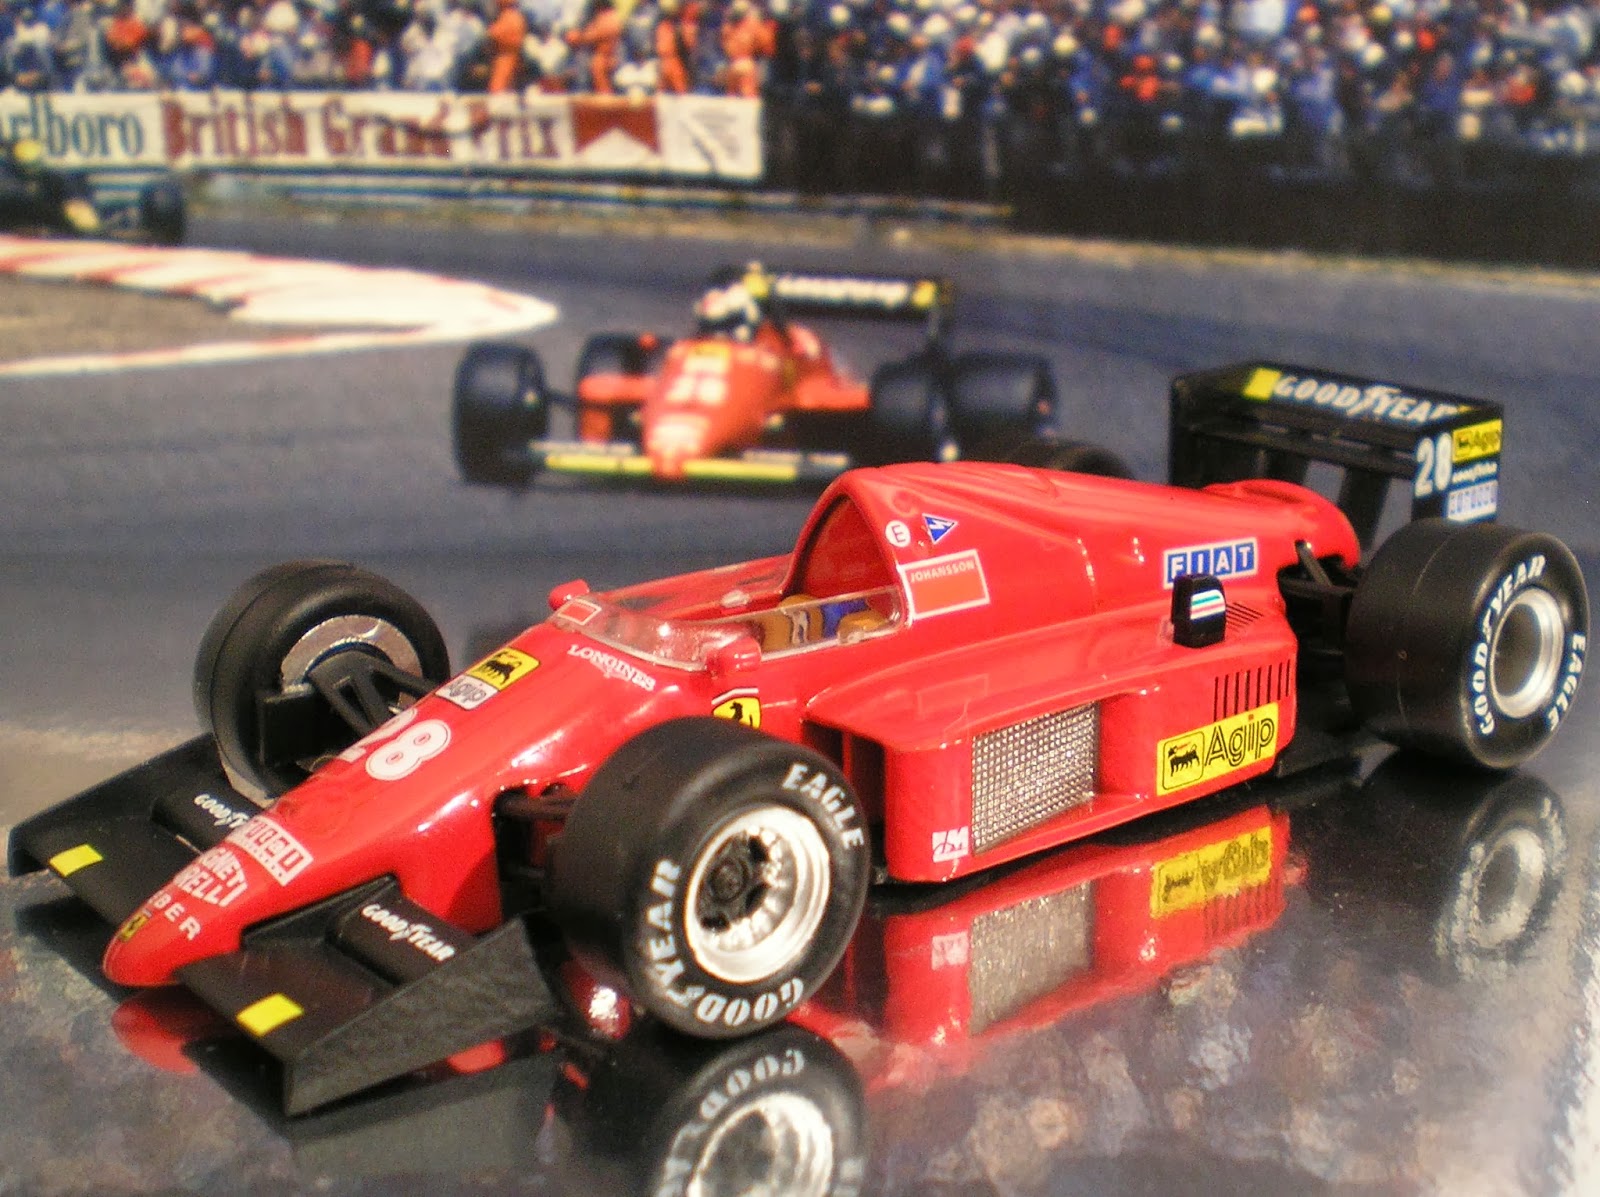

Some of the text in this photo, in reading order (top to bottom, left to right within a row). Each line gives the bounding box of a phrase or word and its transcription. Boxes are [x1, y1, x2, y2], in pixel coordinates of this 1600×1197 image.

[0, 94, 145, 157] rlboro
[161, 91, 309, 160] British
[1274, 375, 1458, 423] GOODYEAR
[891, 524, 907, 544] E
[910, 559, 975, 583] JOHANSSON
[1169, 546, 1253, 579] FIAT
[567, 643, 656, 691] LONGINES
[1548, 634, 1586, 732] EAGLE
[338, 707, 451, 781] 28
[1204, 713, 1275, 768] Agip
[194, 793, 250, 828] GOODY
[782, 763, 864, 850] EAGLE
[148, 890, 201, 941] BER
[361, 903, 455, 962] GOODYEAR
